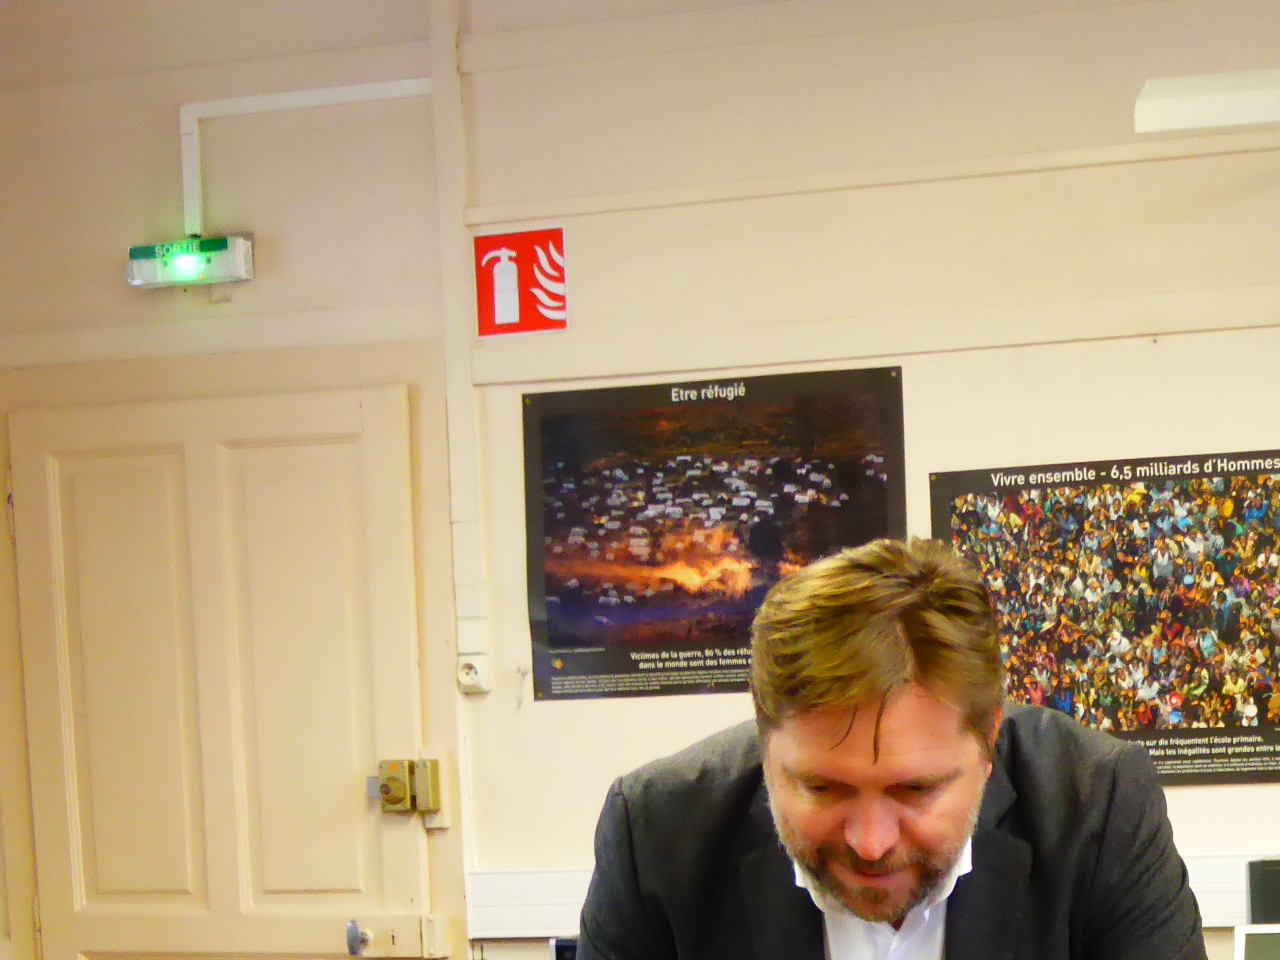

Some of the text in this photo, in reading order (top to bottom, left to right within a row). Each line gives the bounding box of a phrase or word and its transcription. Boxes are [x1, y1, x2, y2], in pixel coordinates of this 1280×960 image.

[155, 241, 201, 258] SORTIE
[671, 381, 746, 402] Etre réfugié
[991, 472, 1025, 487] Vivre
[1029, 467, 1096, 484] ensemble
[1110, 464, 1132, 481] 6,5
[1136, 460, 1200, 478] milliards
[630, 652, 660, 661] Victimes
[661, 650, 670, 660] de
[670, 650, 678, 659] la
[679, 650, 704, 661] guerre,
[723, 648, 736, 657] des
[639, 661, 656, 670] dans
[656, 660, 664, 669] le
[664, 660, 688, 669] monde
[689, 659, 704, 668] sont
[705, 658, 718, 667] des
[719, 657, 747, 666] femmes
[1146, 739, 1158, 747] sur
[1158, 738, 1169, 747] dix
[1169, 737, 1209, 747] fréquentent
[1209, 735, 1232, 745] l'école
[1232, 734, 1264, 745] primaire.
[1149, 748, 1165, 756] Mais
[1166, 747, 1177, 756] les
[1177, 746, 1210, 757] inégalités
[1211, 746, 1227, 755] sont
[1227, 744, 1255, 756] grandes
[1256, 744, 1275, 753] entre
